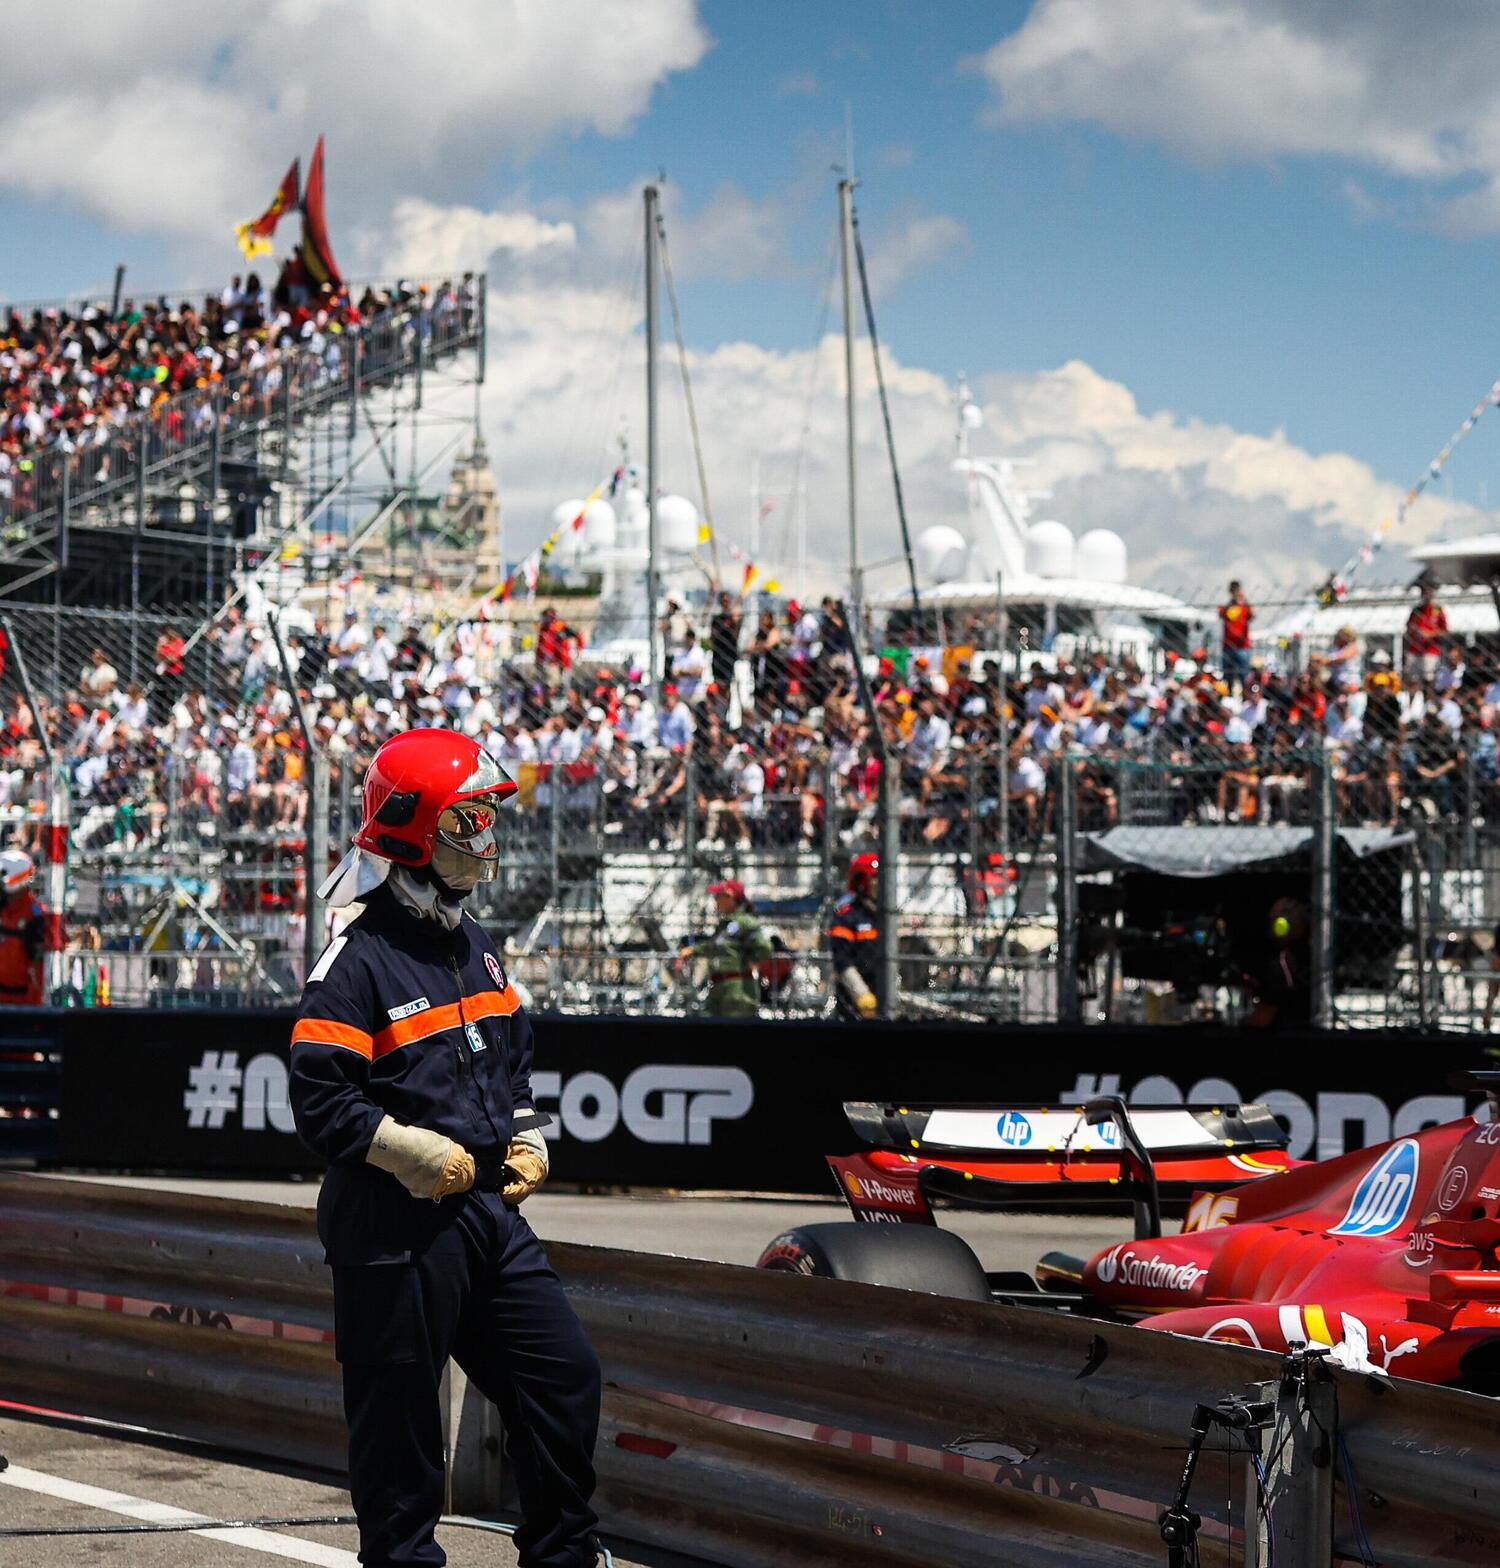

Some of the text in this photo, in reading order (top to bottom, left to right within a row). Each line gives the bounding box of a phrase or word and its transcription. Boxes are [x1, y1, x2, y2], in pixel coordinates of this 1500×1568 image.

[1001, 1110, 1030, 1146] hp
[858, 1177, 917, 1206] V-Power
[1340, 1141, 1413, 1232] hp
[1408, 1232, 1435, 1251] aws
[1120, 1251, 1209, 1290] Santander
